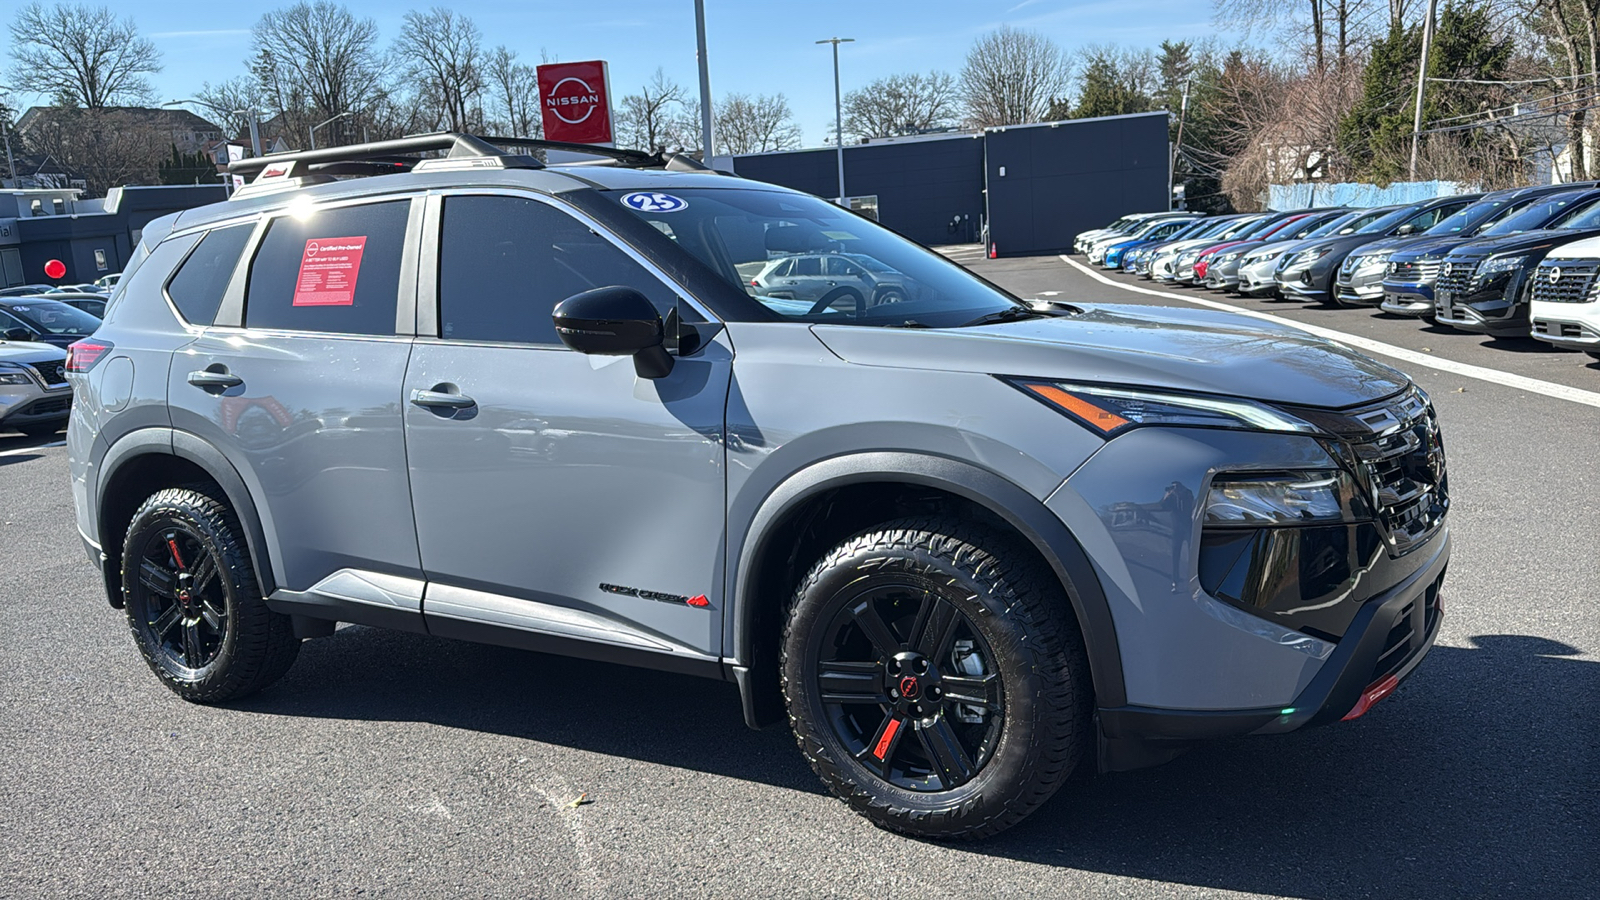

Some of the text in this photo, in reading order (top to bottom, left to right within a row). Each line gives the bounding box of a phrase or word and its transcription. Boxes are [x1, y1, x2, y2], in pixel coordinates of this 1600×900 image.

[546, 95, 599, 106] NISSAN
[632, 193, 676, 211] 25
[599, 582, 690, 607] ROCK CREEK
